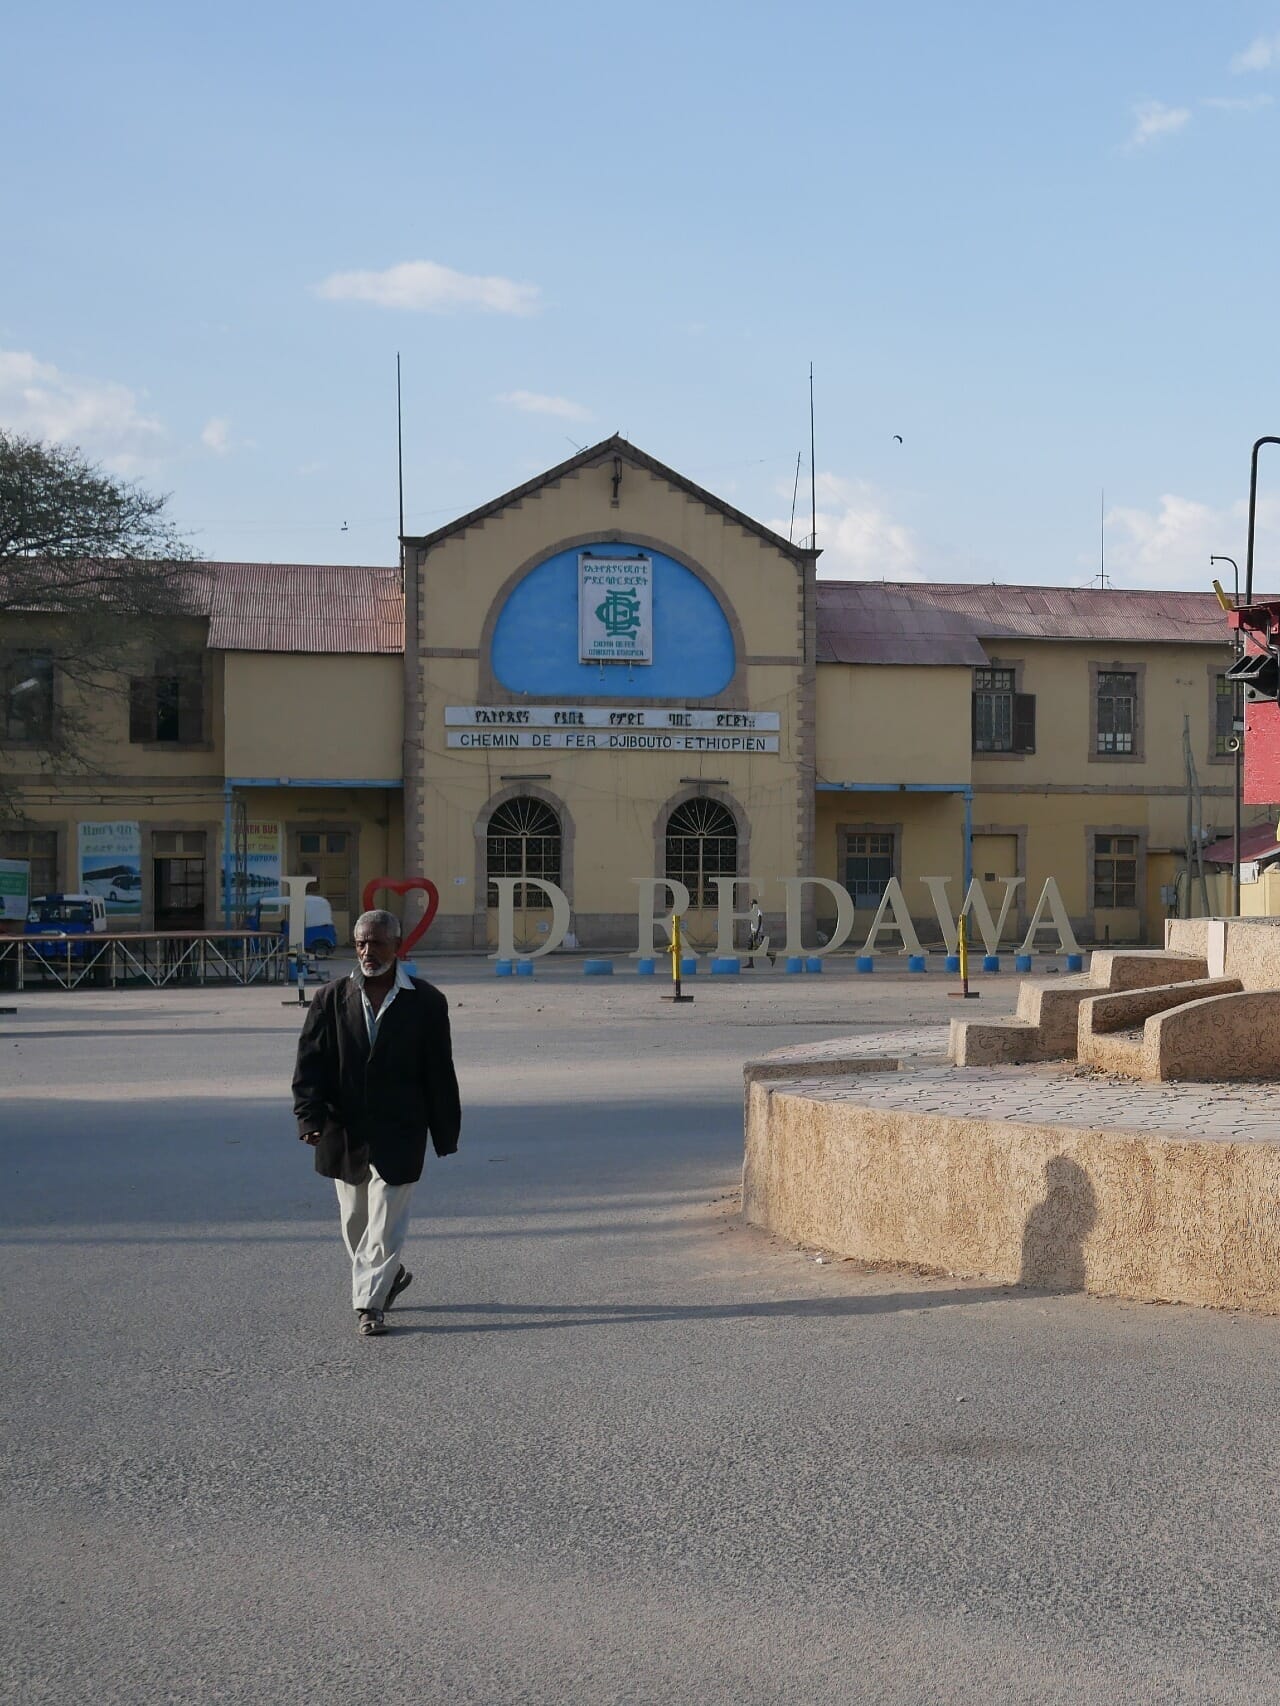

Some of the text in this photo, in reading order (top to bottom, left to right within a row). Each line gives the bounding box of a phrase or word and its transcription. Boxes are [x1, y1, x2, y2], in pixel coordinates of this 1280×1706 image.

[460, 734, 519, 747] CHEMIN
[532, 734, 552, 747] DE
[566, 734, 596, 748] FER
[263, 824, 278, 833] BUS
